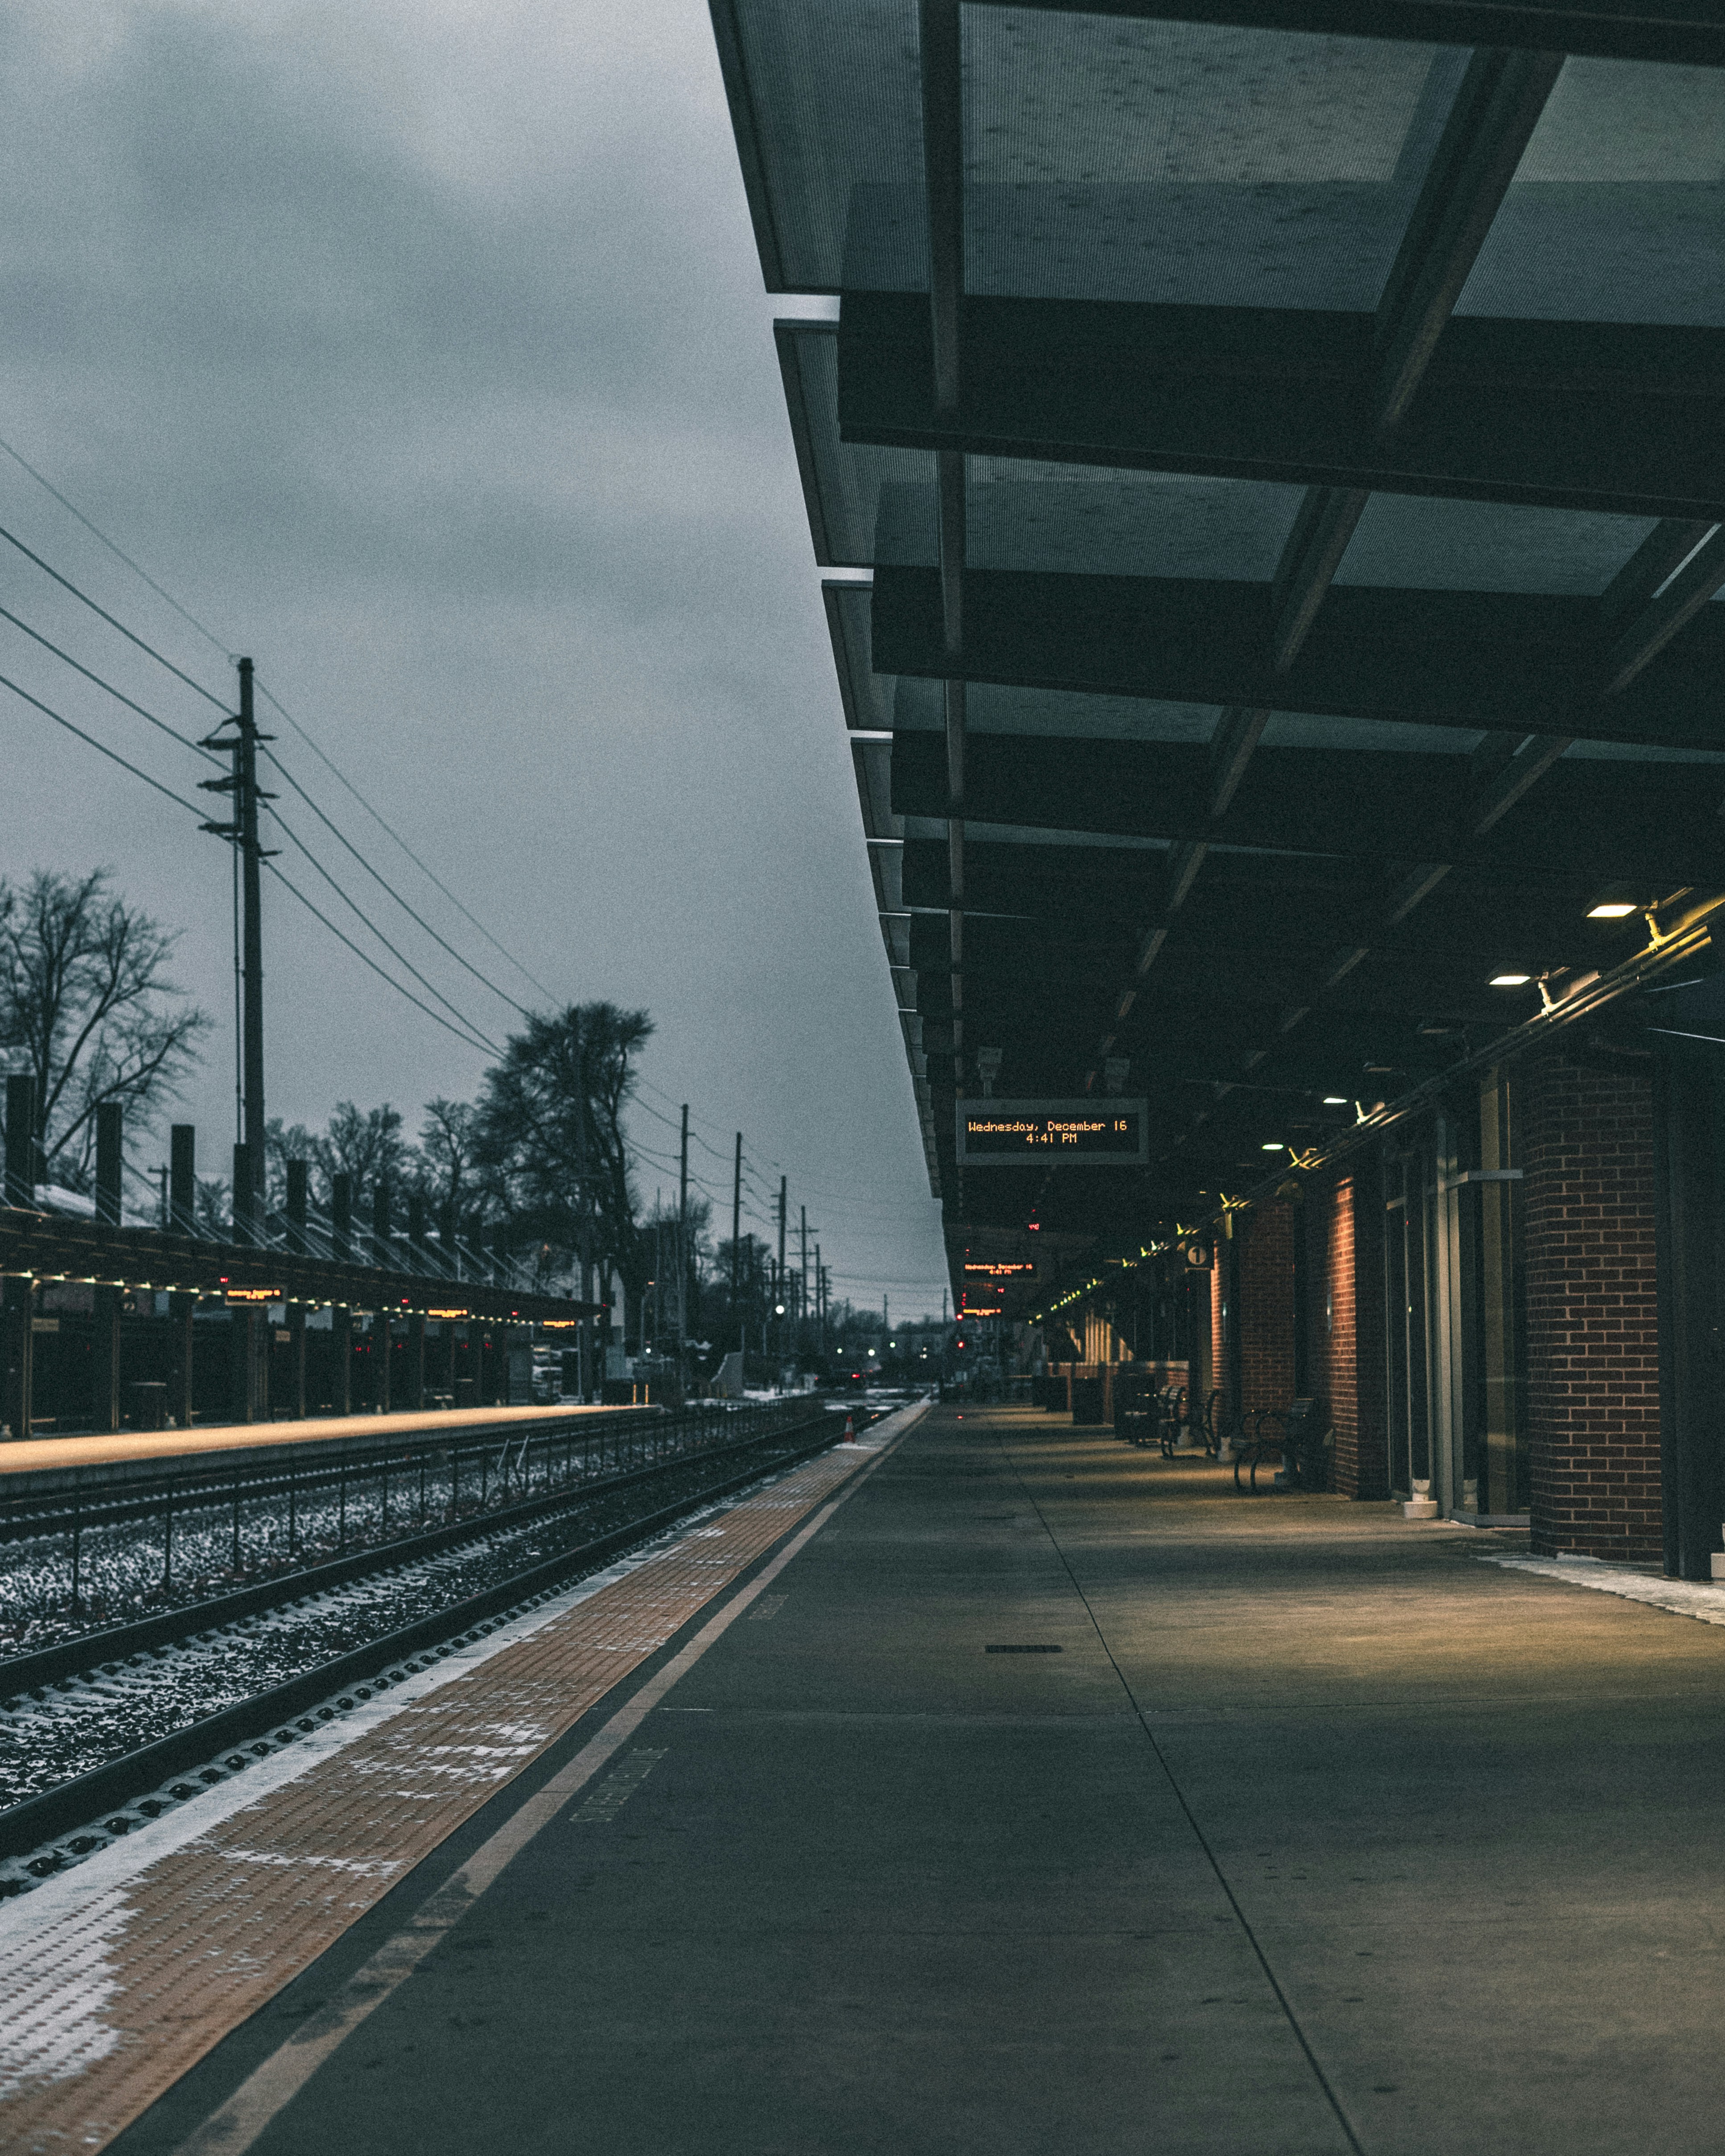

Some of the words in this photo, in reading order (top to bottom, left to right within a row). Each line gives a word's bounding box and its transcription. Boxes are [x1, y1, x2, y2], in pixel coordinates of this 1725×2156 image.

[968, 1121, 1038, 1132] Wednesday,
[1047, 1121, 1106, 1131] December
[1115, 1120, 1127, 1131] 16
[1026, 1133, 1053, 1143] 4:41
[1062, 1133, 1077, 1143] PM
